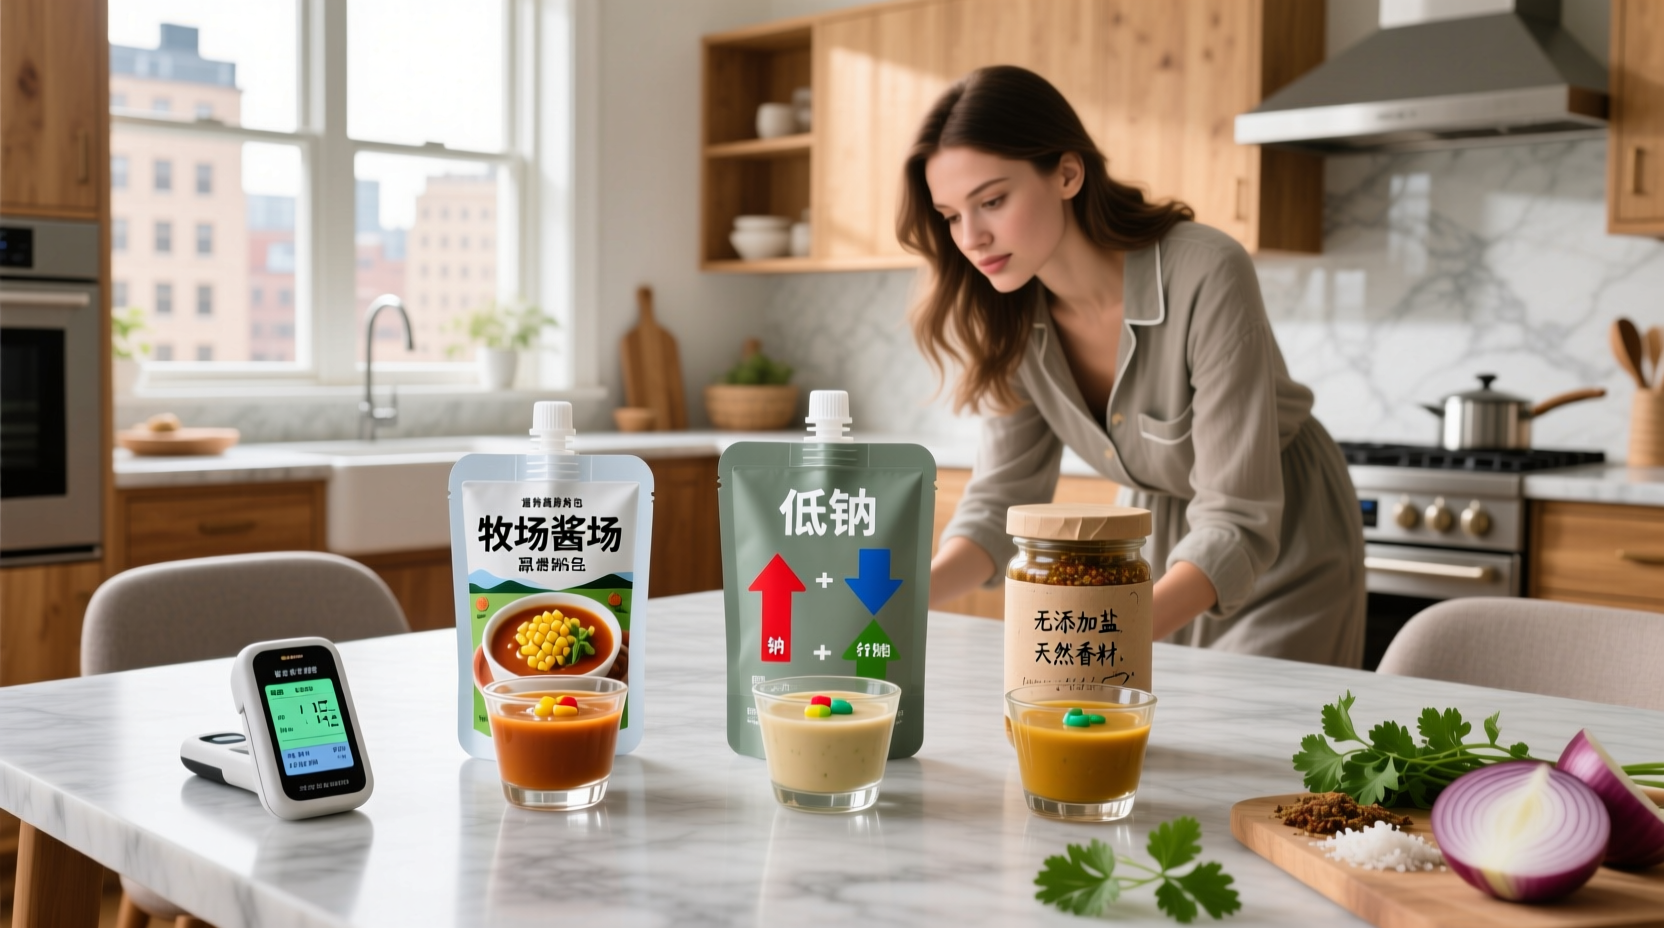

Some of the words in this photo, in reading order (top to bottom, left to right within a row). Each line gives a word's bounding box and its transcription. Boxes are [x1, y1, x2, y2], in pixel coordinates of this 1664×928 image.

[478, 514, 622, 553] 牧场酱场
[779, 487, 876, 537] 低钠
